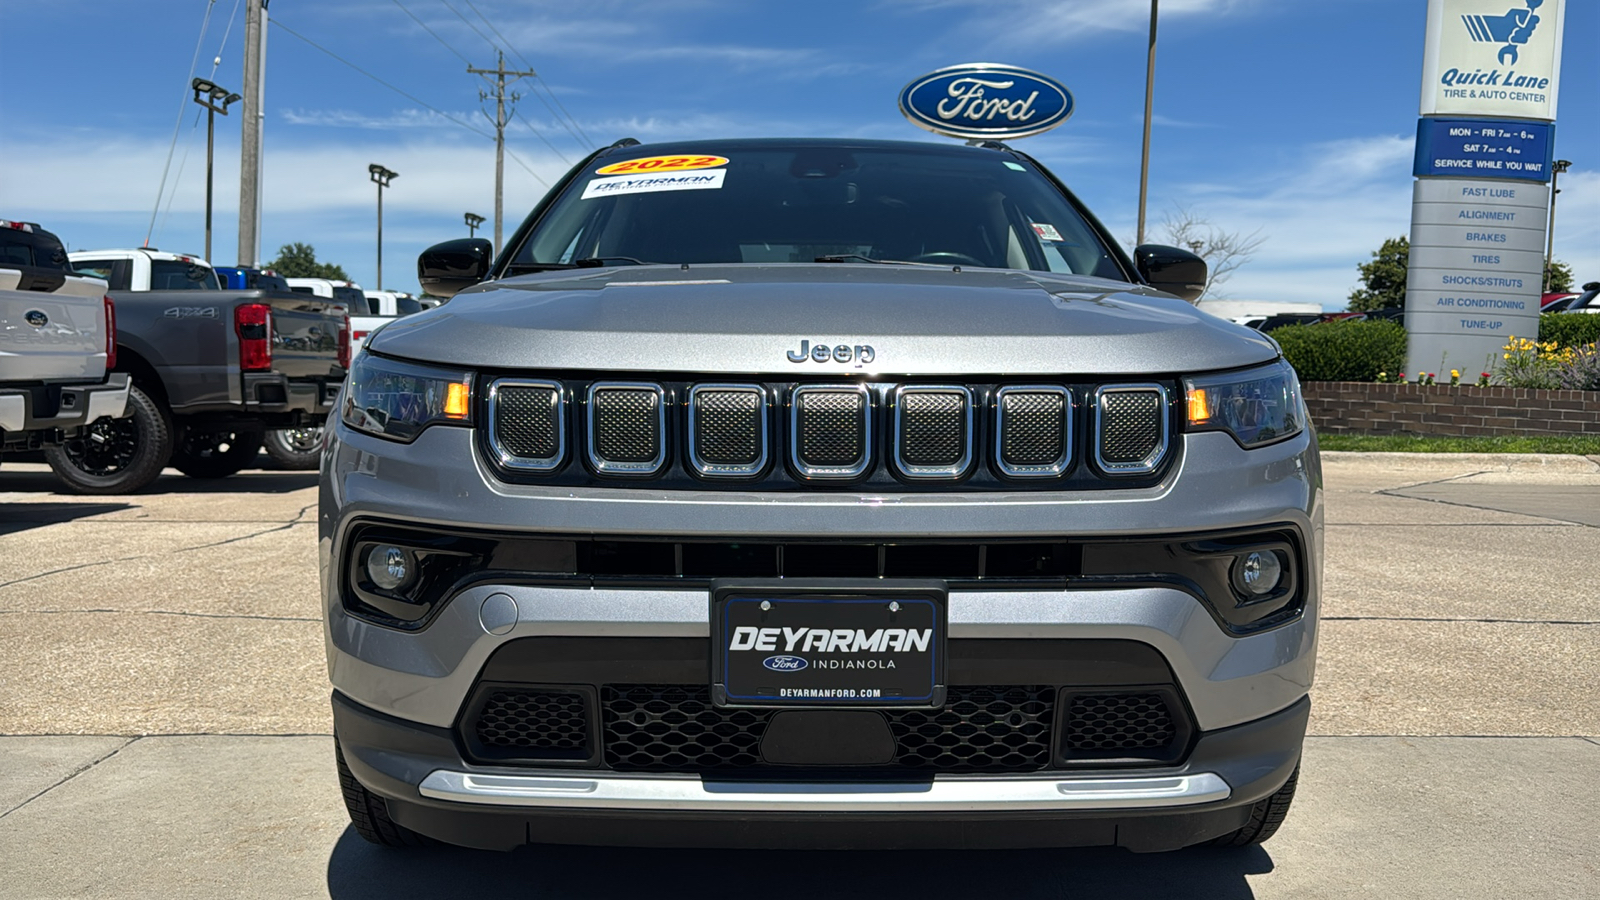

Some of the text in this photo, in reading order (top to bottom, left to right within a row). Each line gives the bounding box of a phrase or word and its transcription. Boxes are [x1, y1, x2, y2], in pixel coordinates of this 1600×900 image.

[1441, 68, 1549, 89] Quick Lane
[937, 78, 1039, 121] Ford
[1443, 89, 1545, 102] TIRE & AUTO CENTER
[1450, 128, 1471, 136] MON
[1482, 129, 1495, 137] FRI
[1463, 144, 1480, 152] SAT
[608, 157, 718, 173] 2022
[1434, 159, 1542, 171] SERVICE WHILE YOU WAIT
[594, 175, 716, 190] DEYARMAN
[1462, 187, 1515, 198] FAST LUBE
[1459, 210, 1516, 221] ALIGNMENT
[1466, 232, 1506, 243] BRAKES
[1472, 255, 1500, 264] TIRES
[1442, 275, 1523, 288] SHOCKS/STRUTS
[1437, 298, 1525, 310] AIR CONDITIONING
[1460, 319, 1503, 330] TUNE-UP
[786, 340, 875, 368] Jeep
[729, 626, 933, 652] DEYARMAN
[772, 657, 896, 669] Ford INDIANOLA
[780, 688, 881, 698] DEYARMANFORD.COM
